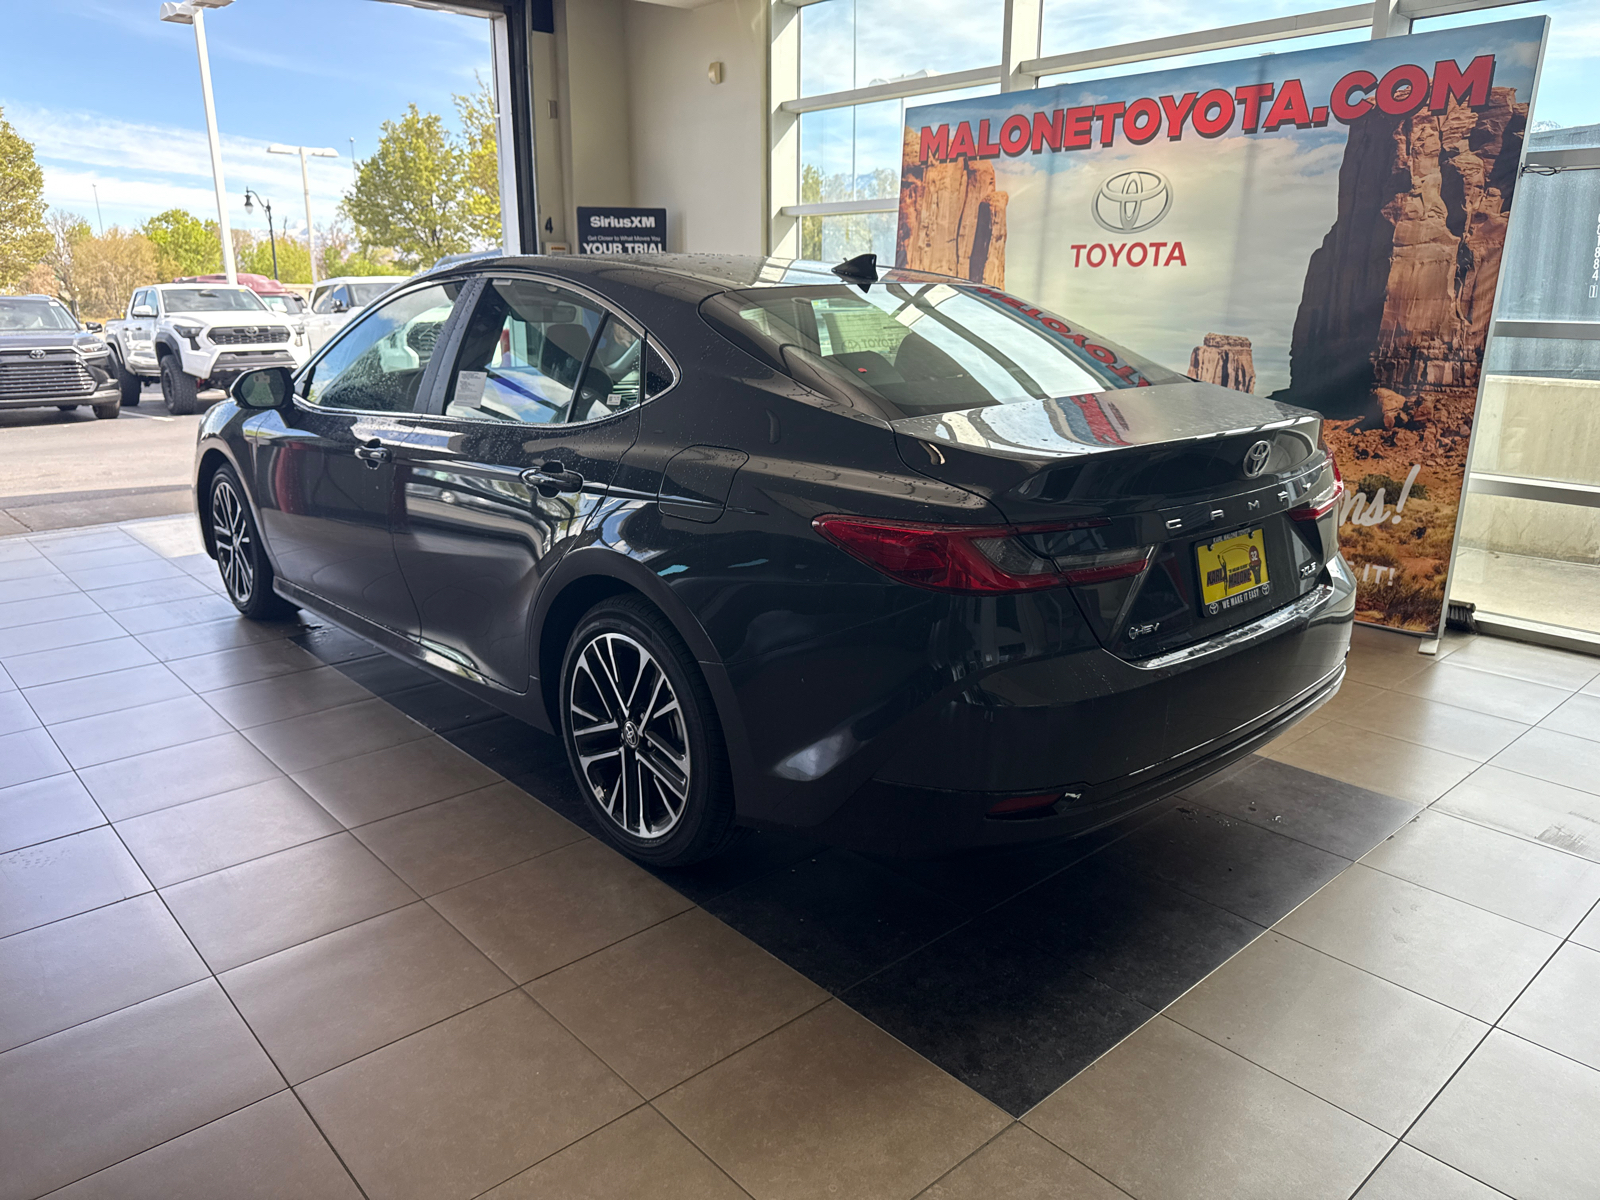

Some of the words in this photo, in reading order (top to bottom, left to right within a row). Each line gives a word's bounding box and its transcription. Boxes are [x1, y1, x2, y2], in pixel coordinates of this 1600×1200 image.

[919, 53, 1497, 165] MALONETOYOTA.COM
[544, 216, 554, 235] 4
[589, 215, 656, 229] SiriusXM
[582, 242, 623, 255] YOUR
[625, 242, 667, 255] TRIAL
[1070, 240, 1188, 269] TOYOTA
[1339, 463, 1422, 527] ns!
[1250, 550, 1258, 561] 32
[1362, 563, 1396, 587] IT!
[1221, 599, 1231, 610] WE
[1230, 594, 1243, 606] MAKE
[1248, 588, 1260, 600] EASY
